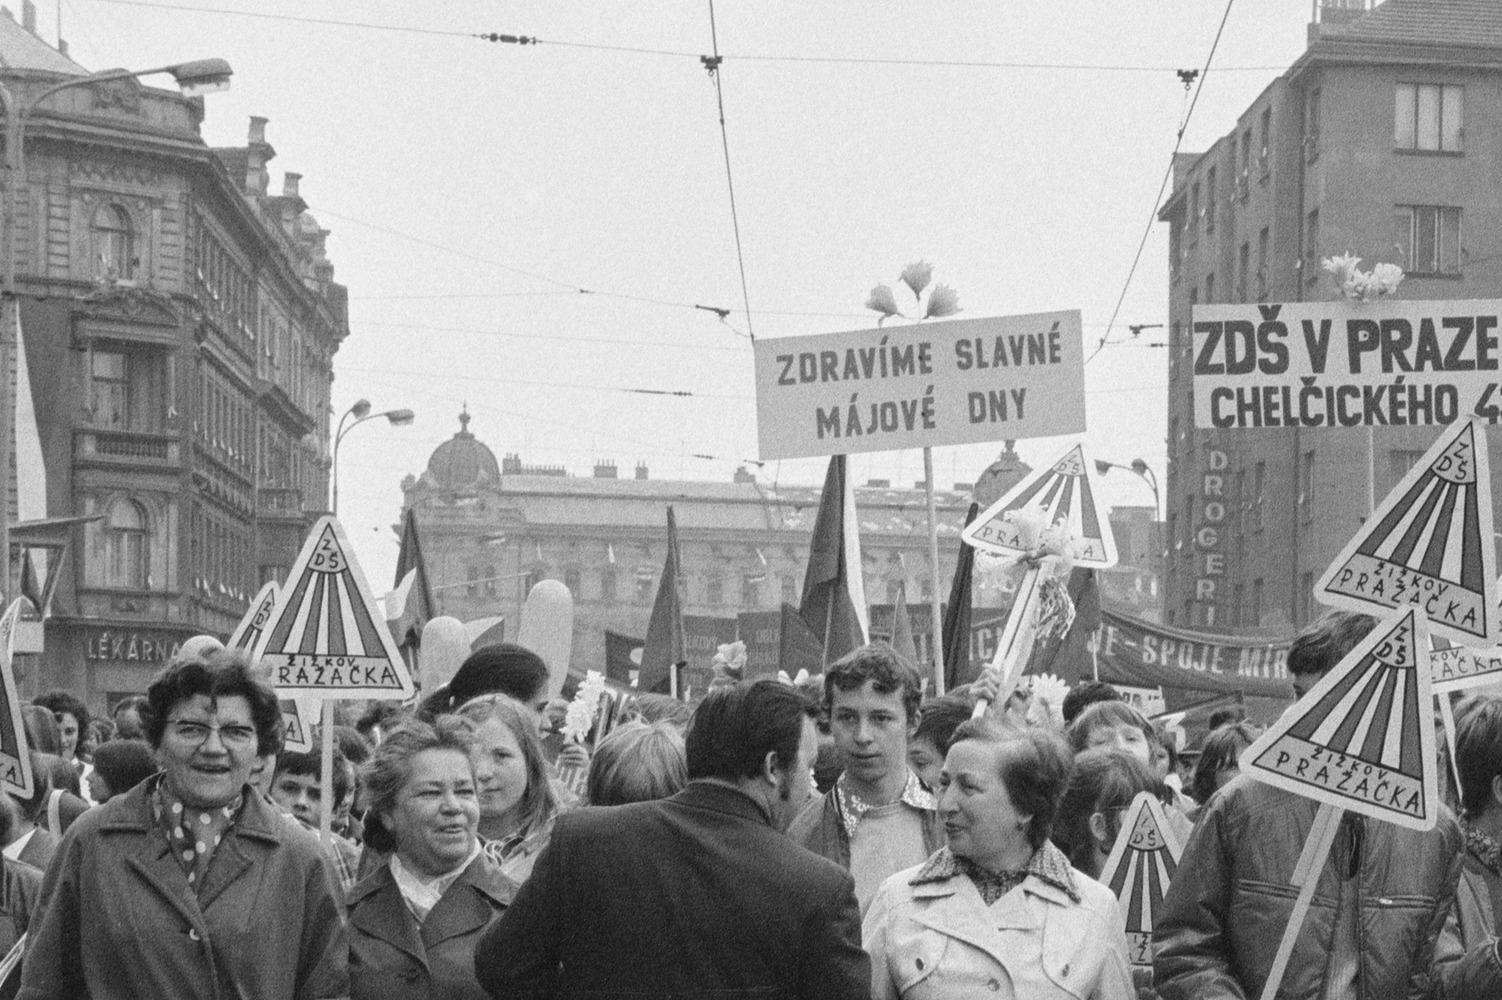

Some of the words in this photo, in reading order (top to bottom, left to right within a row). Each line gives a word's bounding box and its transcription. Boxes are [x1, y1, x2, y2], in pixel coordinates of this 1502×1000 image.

[776, 335, 933, 386] ZDRAVÍME
[955, 321, 1062, 371] SLAVNÉ
[1193, 304, 1290, 376] ZDŠ
[1301, 318, 1333, 374] V
[1346, 315, 1499, 374] PRAZE
[816, 385, 936, 440] MÁJOVÉ
[968, 388, 1027, 424] DNY
[1211, 375, 1459, 428] CHELČICKÉHO
[1454, 442, 1469, 459] Z
[1436, 456, 1467, 480] DŠ
[322, 539, 332, 550] Z
[314, 551, 339, 569] DŠ
[1374, 562, 1449, 596] ŽIŽKOV
[1340, 569, 1476, 628] PRAŽAČKA
[1394, 626, 1409, 642] Z
[287, 653, 355, 667] ŽIŽKOV
[1376, 642, 1407, 666] DŠ
[278, 665, 396, 685] RAŽAČKA
[1311, 747, 1388, 780] ŽIŽKOV
[1276, 751, 1419, 813] PRAŽAČKA
